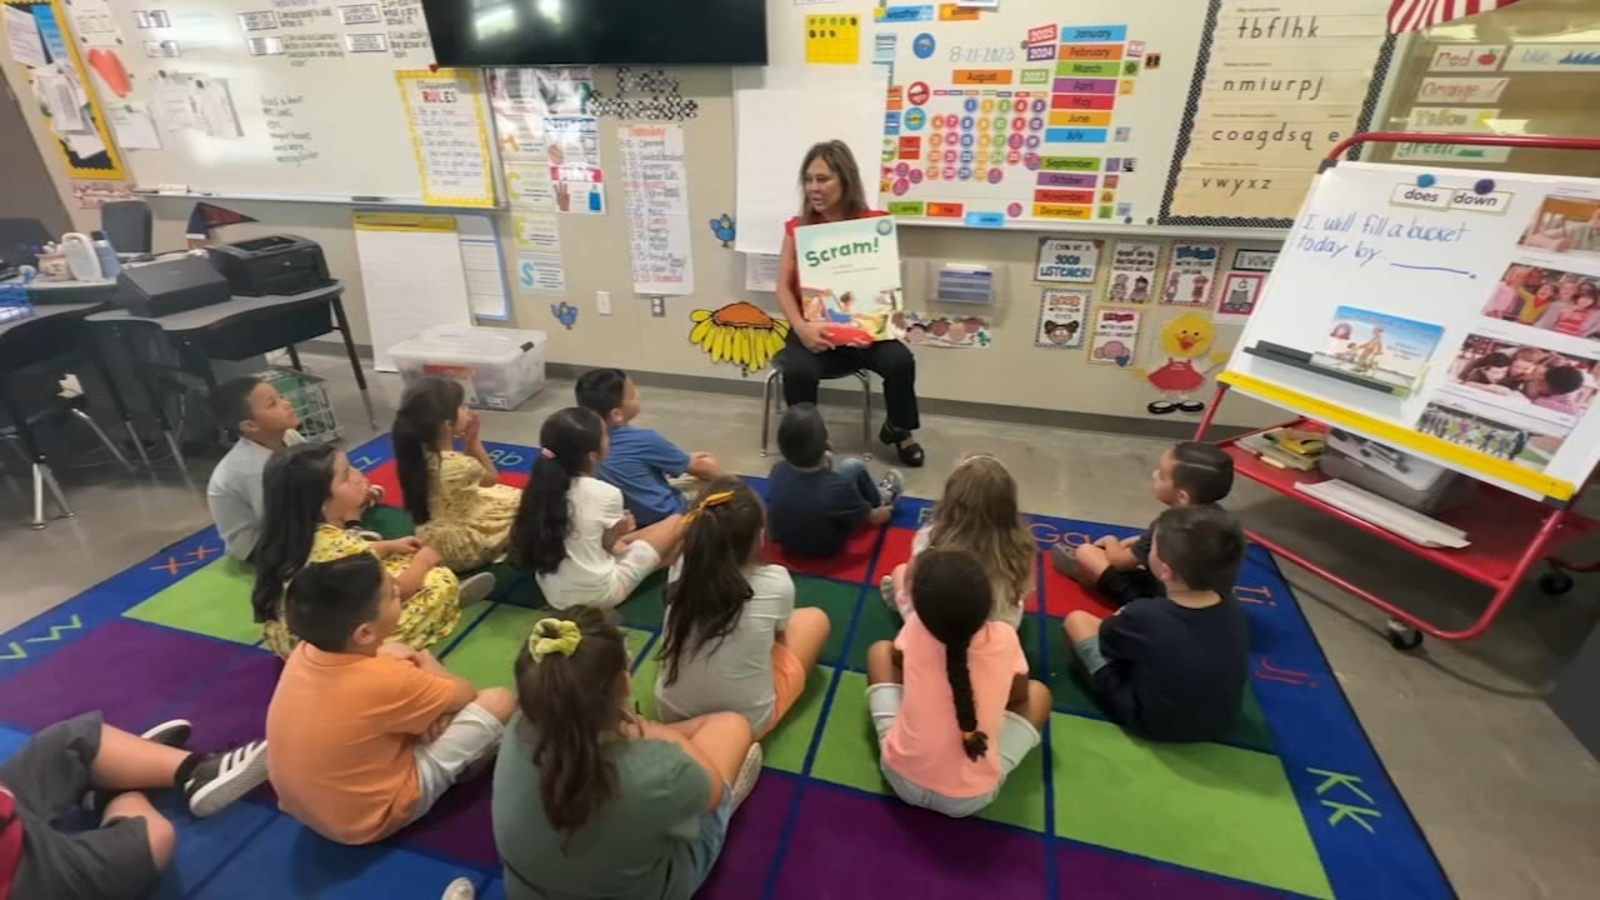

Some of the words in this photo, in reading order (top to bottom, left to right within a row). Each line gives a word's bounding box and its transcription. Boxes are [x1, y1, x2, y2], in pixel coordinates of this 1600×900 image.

[1073, 29, 1112, 40] January
[1029, 46, 1054, 59] 2024
[1069, 46, 1111, 58] February
[1073, 63, 1103, 72] March
[966, 72, 997, 83] August
[1073, 81, 1094, 90] April
[422, 91, 459, 103] RULES
[1073, 97, 1093, 108] May
[1067, 114, 1091, 123] June
[1066, 130, 1085, 140] July
[1045, 158, 1094, 169] September
[1049, 174, 1085, 184] October
[1040, 192, 1086, 202] November
[1404, 188, 1440, 203] does
[1453, 191, 1498, 207] down
[1039, 206, 1084, 216] December
[1303, 214, 1320, 230] I
[1323, 212, 1357, 232] will
[1362, 214, 1388, 237] fill
[1388, 224, 1402, 238] a
[1405, 219, 1471, 242] bucket
[1297, 234, 1348, 258] today
[804, 236, 879, 268] Scram!
